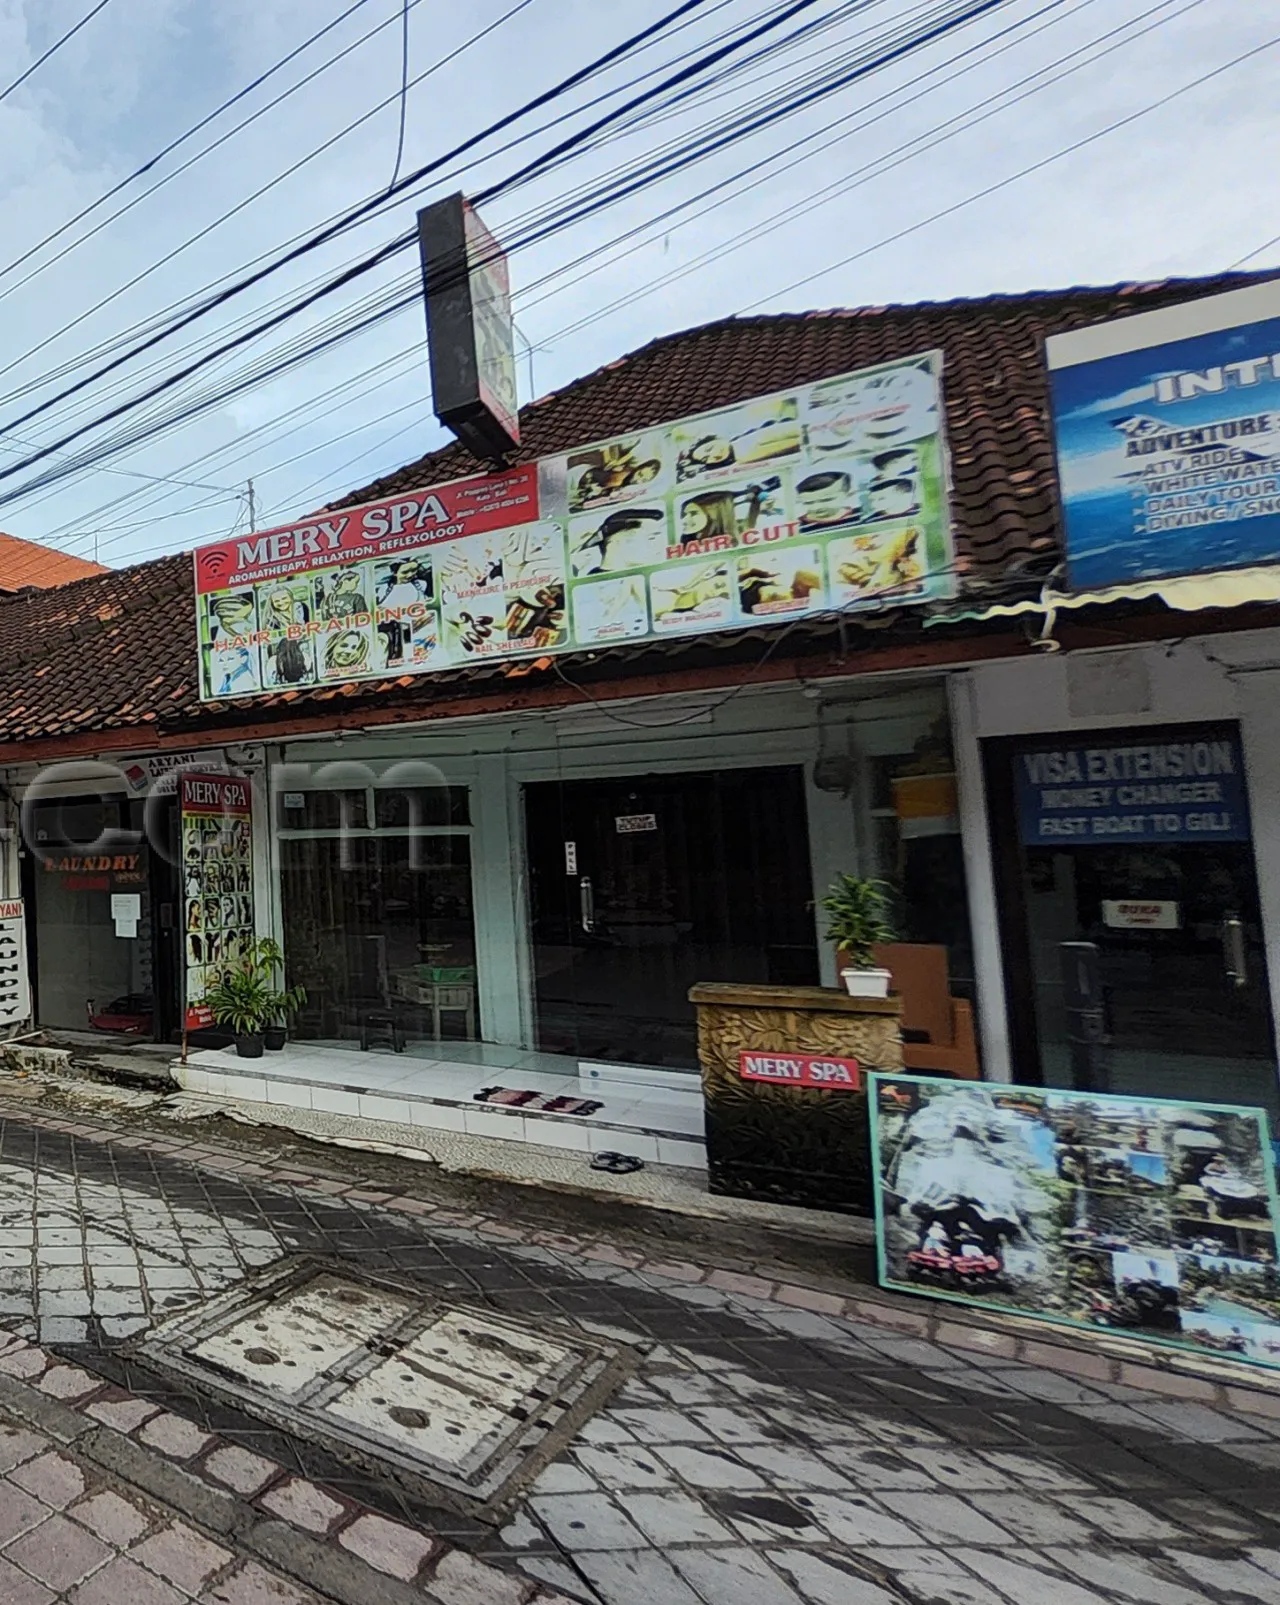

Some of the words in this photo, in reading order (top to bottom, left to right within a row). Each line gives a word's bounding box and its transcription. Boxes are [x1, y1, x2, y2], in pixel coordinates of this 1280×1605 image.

[1155, 353, 1280, 406] INT
[1125, 415, 1272, 457] ADVENTURE
[1144, 459, 1185, 477] ATV
[1190, 447, 1243, 468] RIDE
[1145, 473, 1218, 495] WHITE
[1147, 490, 1212, 514] DAILY
[236, 518, 350, 569] MERY
[361, 495, 450, 541] SPA
[1148, 506, 1227, 531] DIVING
[228, 558, 309, 585] AROMATHERAPY,
[311, 544, 376, 570] RELAXTION,
[379, 523, 465, 551] REFLEXOLOGY
[666, 533, 734, 560] HAIR
[742, 522, 801, 546] CUT
[214, 630, 270, 652] HAIR
[286, 602, 427, 642] BRAIDING
[148, 754, 196, 768] ARYANI
[1024, 752, 1083, 784] VISA
[1085, 741, 1234, 780] EXTENSION
[184, 781, 220, 804] MERY
[224, 785, 246, 806] SPA
[1039, 817, 1088, 836] FAST
[1092, 815, 1145, 834] BOAT
[1147, 813, 1181, 832] TO
[44, 854, 140, 871] LAUNDRY
[745, 1056, 803, 1079] MERY
[809, 1062, 852, 1083] SPA
